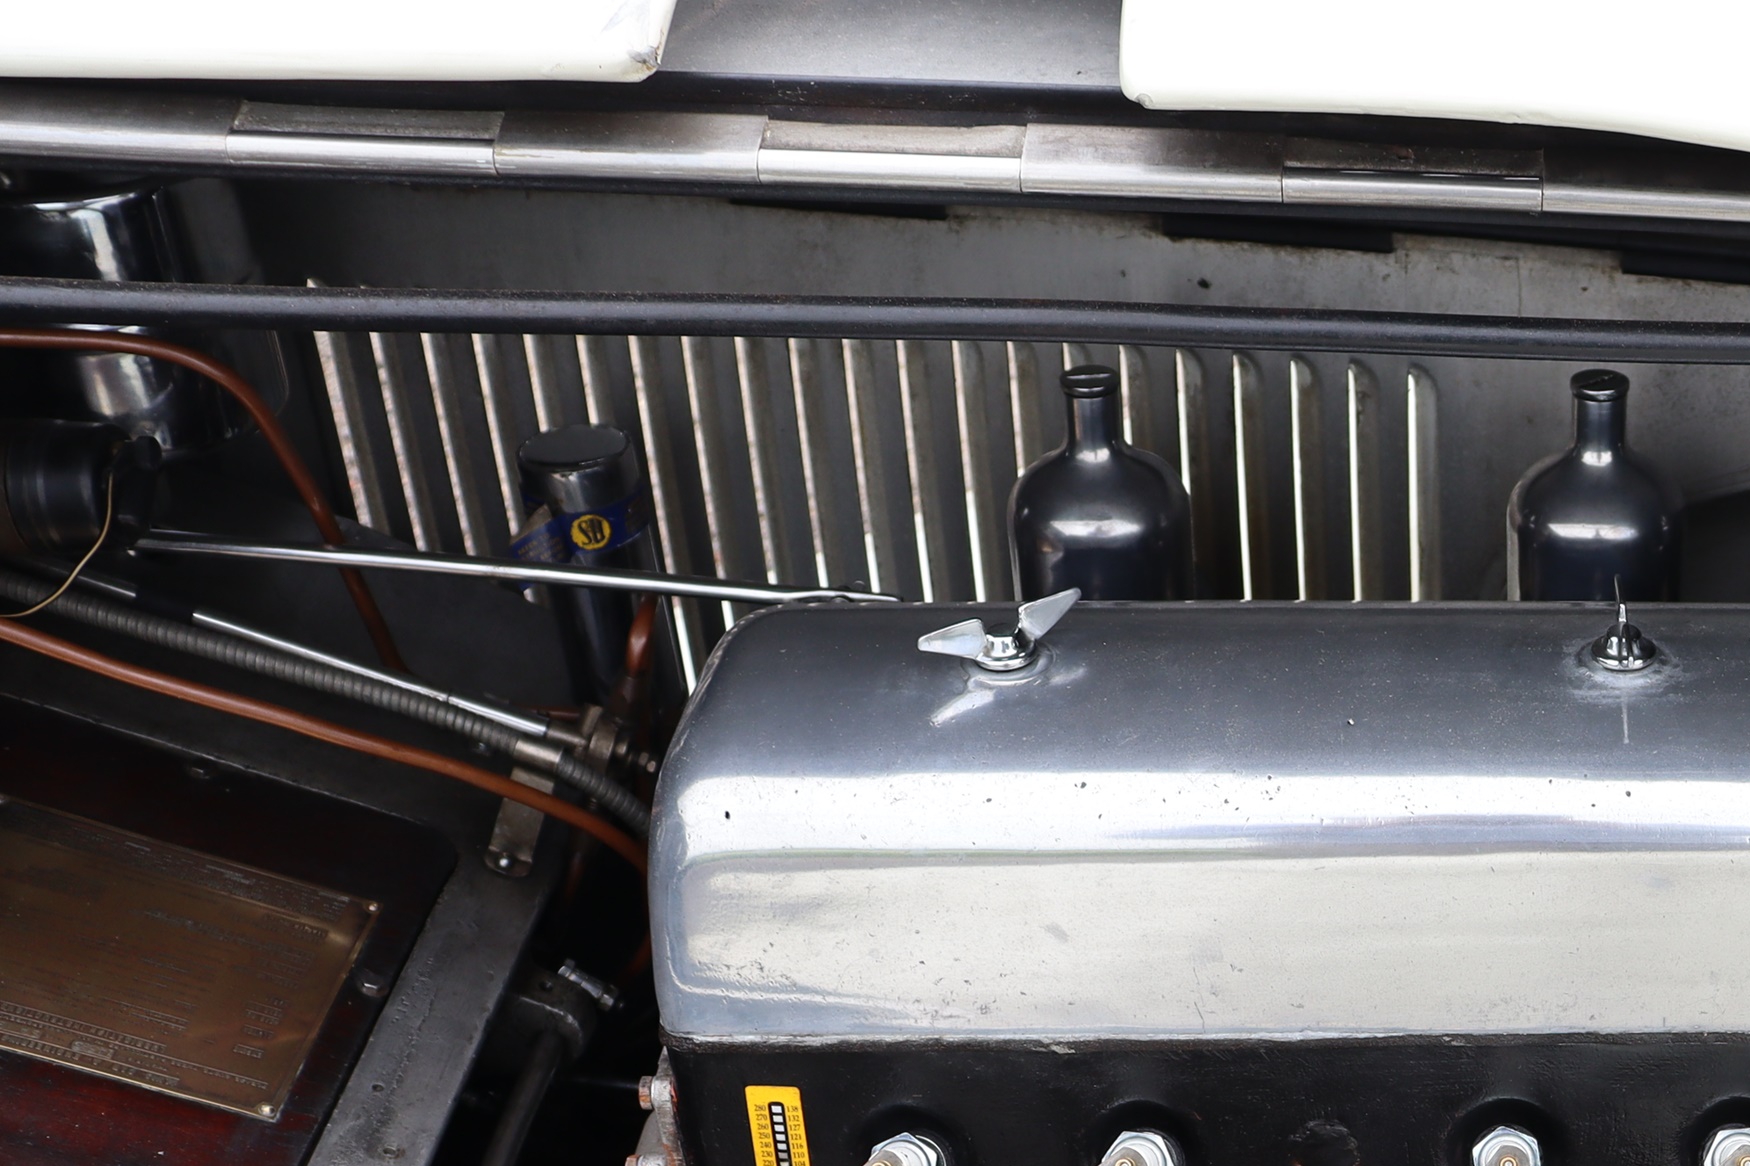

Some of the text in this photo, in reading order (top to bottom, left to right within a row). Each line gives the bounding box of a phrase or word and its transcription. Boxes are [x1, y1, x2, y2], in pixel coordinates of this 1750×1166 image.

[754, 1104, 799, 1113] 280 138
[755, 1113, 800, 1122] 270 132
[757, 1123, 801, 1132] 260 127
[758, 1132, 802, 1141] 250 121
[760, 1141, 804, 1150] 240 116
[761, 1150, 806, 1159] 230 110
[762, 1159, 775, 1166] 220
